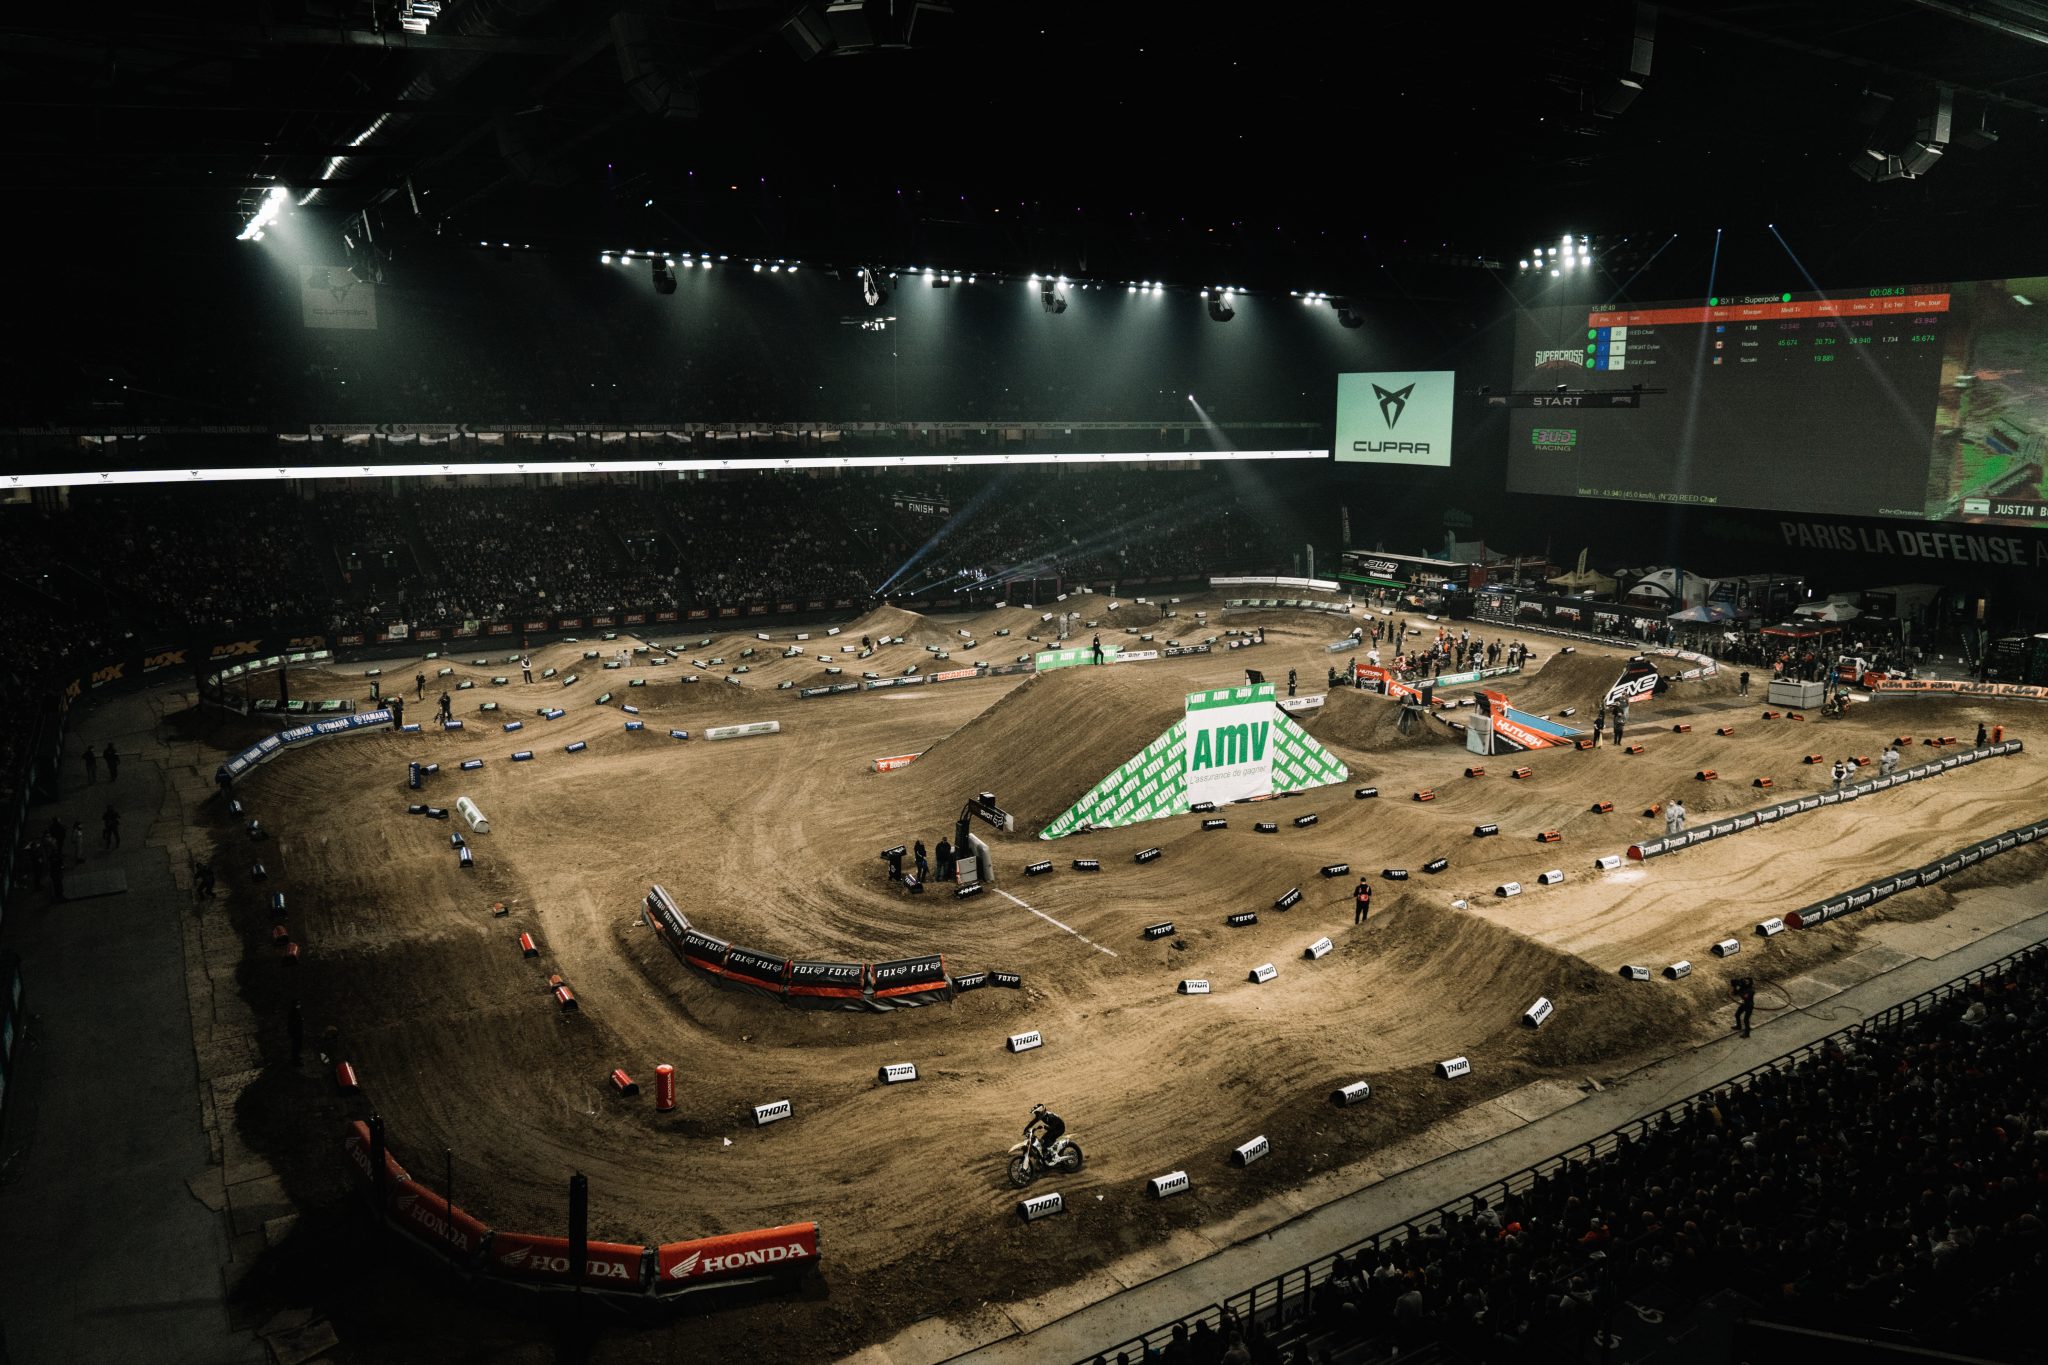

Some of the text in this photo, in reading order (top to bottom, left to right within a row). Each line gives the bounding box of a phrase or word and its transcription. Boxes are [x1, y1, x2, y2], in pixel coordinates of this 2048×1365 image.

[1870, 288, 1905, 296] 00:08:43
[1744, 295, 1780, 304] Superpole
[1535, 350, 1584, 367] SUPERCROSS
[1533, 397, 1582, 406] START
[1353, 440, 1430, 454] CUPRA
[908, 502, 934, 514] FINISH
[1994, 504, 2034, 516] JUSTIN
[1780, 522, 1856, 550] PARIS
[1859, 528, 1896, 554] LA
[1896, 530, 2028, 566] DEFENSE
[938, 669, 977, 682] BRAKING
[1958, 684, 1995, 694] KTM
[2002, 686, 2038, 696] KTM
[360, 710, 390, 722] YAMAHA
[323, 718, 350, 732] YAMAHA
[288, 726, 314, 739] YAMAHA
[1232, 769, 1240, 777] de
[1243, 766, 1266, 777] gagner
[1803, 800, 1819, 810] THOR
[1824, 794, 1839, 804] THOR
[980, 810, 994, 821] SHOT
[1782, 804, 1798, 815] THOR
[1738, 816, 1756, 828] THOR
[1762, 810, 1778, 822] THOR
[1716, 824, 1733, 835] THOR
[1668, 836, 1686, 848] THOR
[1693, 830, 1710, 842] THOR
[1644, 843, 1662, 855] THOR
[1878, 884, 1894, 897] THOR
[1853, 892, 1871, 906] THOR
[1828, 902, 1846, 916] THOR
[1803, 912, 1820, 926] THOR
[1153, 926, 1166, 936] FOX
[1766, 921, 1782, 931] THOR
[686, 935, 699, 945] FOX
[705, 942, 718, 952] FOX
[1314, 940, 1331, 954] THOR
[1724, 943, 1738, 952] THOR
[730, 952, 746, 963] FOX
[756, 960, 774, 971] FOX
[793, 966, 814, 974] FOX
[828, 967, 848, 976] FOX
[910, 964, 930, 973] FOX
[1676, 964, 1691, 974] THOR
[876, 968, 896, 978] FOX
[998, 974, 1012, 982] FOX
[1258, 966, 1276, 978] THOR
[1633, 968, 1648, 976] THOR
[962, 978, 976, 987] FOX
[1188, 981, 1208, 990] THOR
[1533, 1002, 1550, 1020] THOR
[1015, 1033, 1040, 1048] THOR
[1448, 1060, 1468, 1074] THOR
[1346, 1086, 1368, 1102] THOR
[758, 1103, 789, 1119] THOR
[1244, 1140, 1270, 1161] THOR
[352, 1146, 374, 1184] HON
[1028, 1196, 1061, 1215] THOR
[411, 1203, 469, 1252] HONDA
[701, 1242, 808, 1274] HONDA
[529, 1256, 631, 1280] HODA
